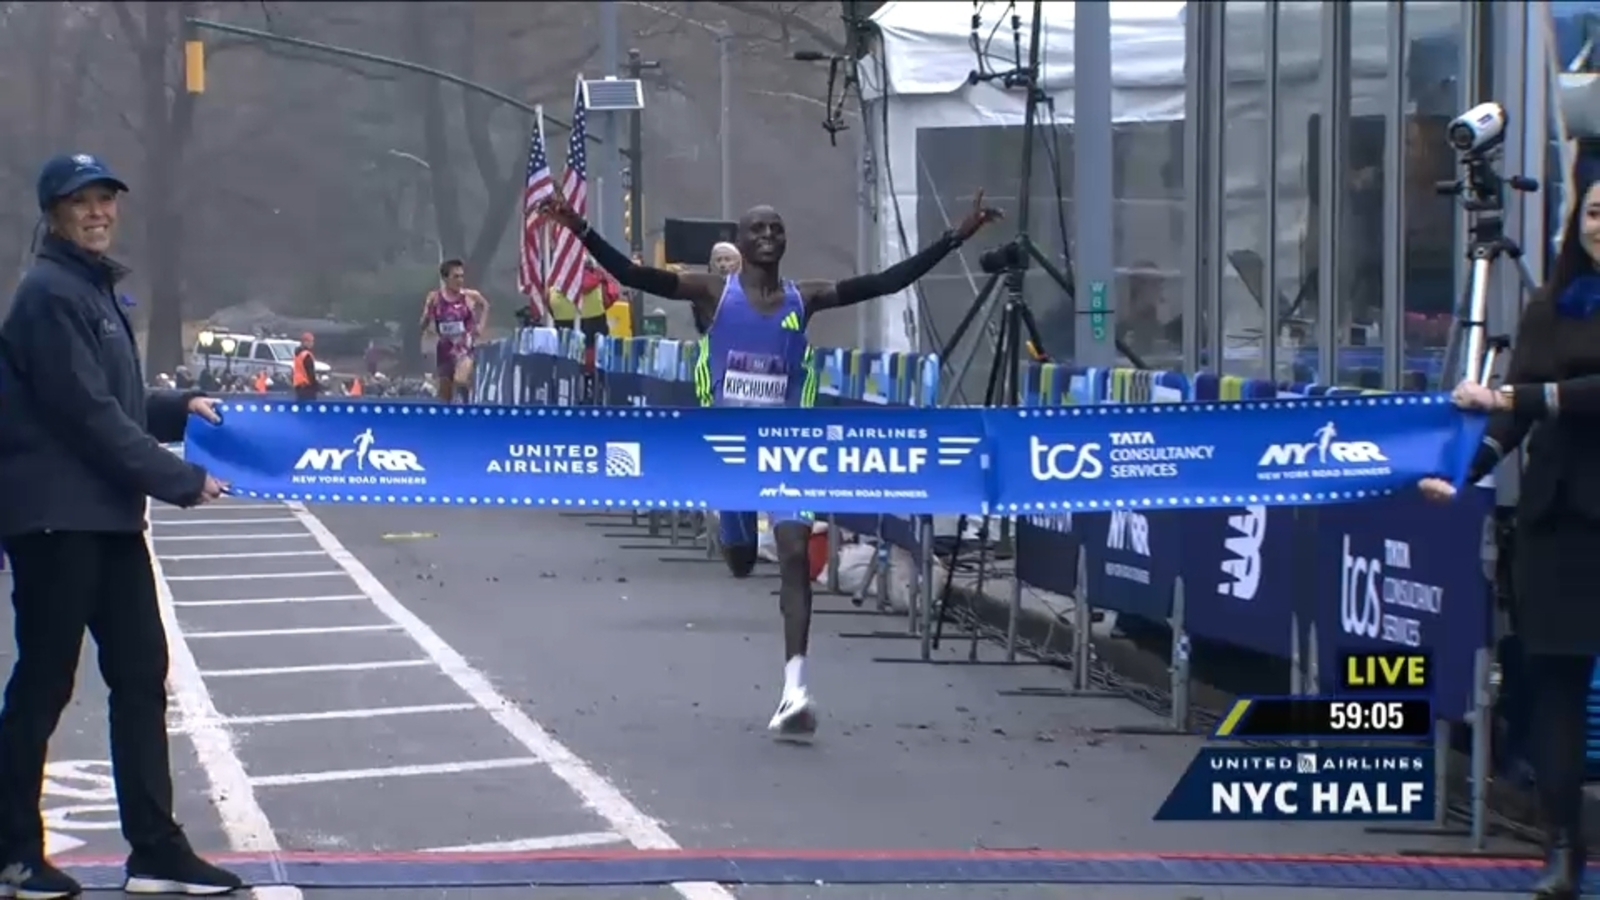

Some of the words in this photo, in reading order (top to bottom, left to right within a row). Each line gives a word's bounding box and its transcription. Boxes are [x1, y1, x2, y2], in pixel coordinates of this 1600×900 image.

[758, 427, 823, 438] UNITED
[847, 428, 928, 439] AIRLINES
[1109, 431, 1155, 445] TATA
[509, 444, 598, 458] UNITED
[1031, 435, 1103, 480] tcs
[1109, 445, 1215, 461] CONSULTANCY
[758, 446, 828, 473] NYC
[838, 447, 928, 473] HALF
[486, 460, 599, 474] AIRLINES
[1110, 463, 1178, 478] SERVICES
[1256, 471, 1280, 480] NEW
[1282, 470, 1310, 479] YORK
[1311, 469, 1341, 478] ROAD
[1342, 467, 1391, 477] RUNNERS
[292, 475, 316, 484] NEW
[318, 475, 346, 484] YORK
[348, 476, 377, 485] ROAD
[379, 476, 427, 485] RUNNERS
[804, 488, 826, 497] NEW
[828, 488, 854, 498] YORK
[855, 488, 882, 498] ROAD
[883, 488, 929, 498] RUNNERS
[1341, 532, 1381, 639] tcs
